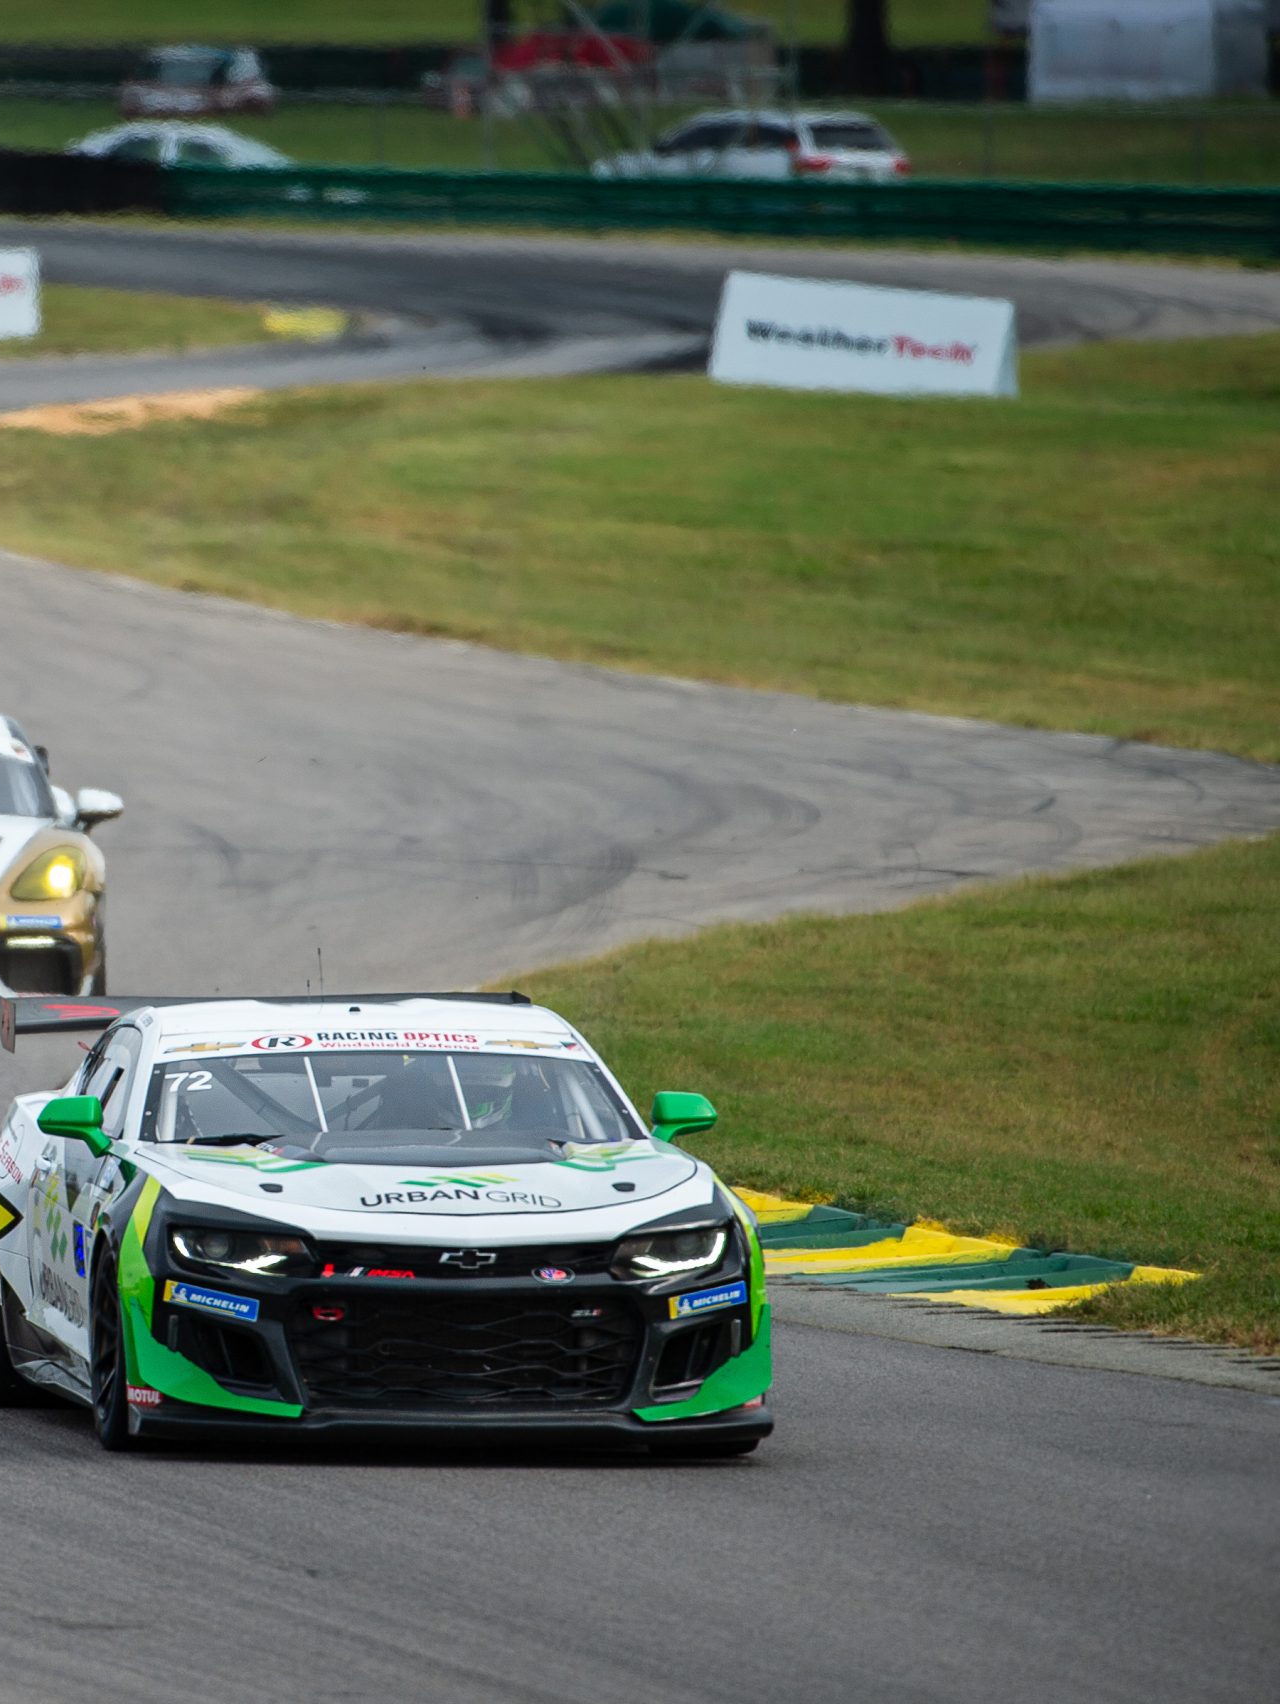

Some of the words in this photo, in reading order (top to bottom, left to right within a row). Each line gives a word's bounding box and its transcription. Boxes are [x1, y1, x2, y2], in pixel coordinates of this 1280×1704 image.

[746, 319, 976, 367] WeatherTech
[316, 1032, 399, 1042] RACING
[403, 1032, 478, 1044] OPTICS
[415, 1042, 481, 1050] Defense
[164, 1070, 213, 1092] 72
[359, 1189, 481, 1207] URBAN
[485, 1190, 562, 1208] GRID
[189, 1293, 250, 1313] MICHELIN
[692, 1290, 741, 1307] MICHELIN
